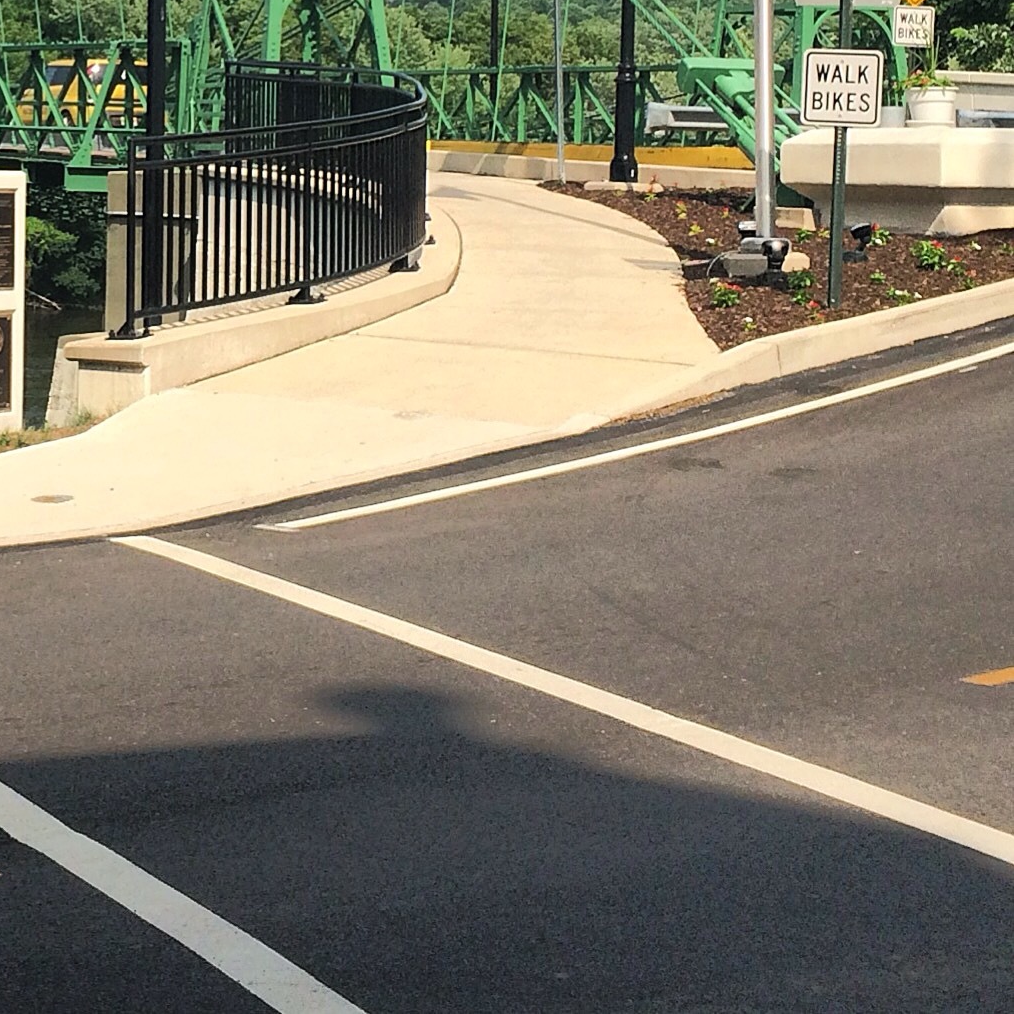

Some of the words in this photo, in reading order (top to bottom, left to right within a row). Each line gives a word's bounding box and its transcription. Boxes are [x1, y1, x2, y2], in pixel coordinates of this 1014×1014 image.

[900, 13, 928, 26] WALK
[898, 28, 930, 40] BIKES
[816, 63, 869, 84] WALK
[811, 91, 871, 113] BIKES
